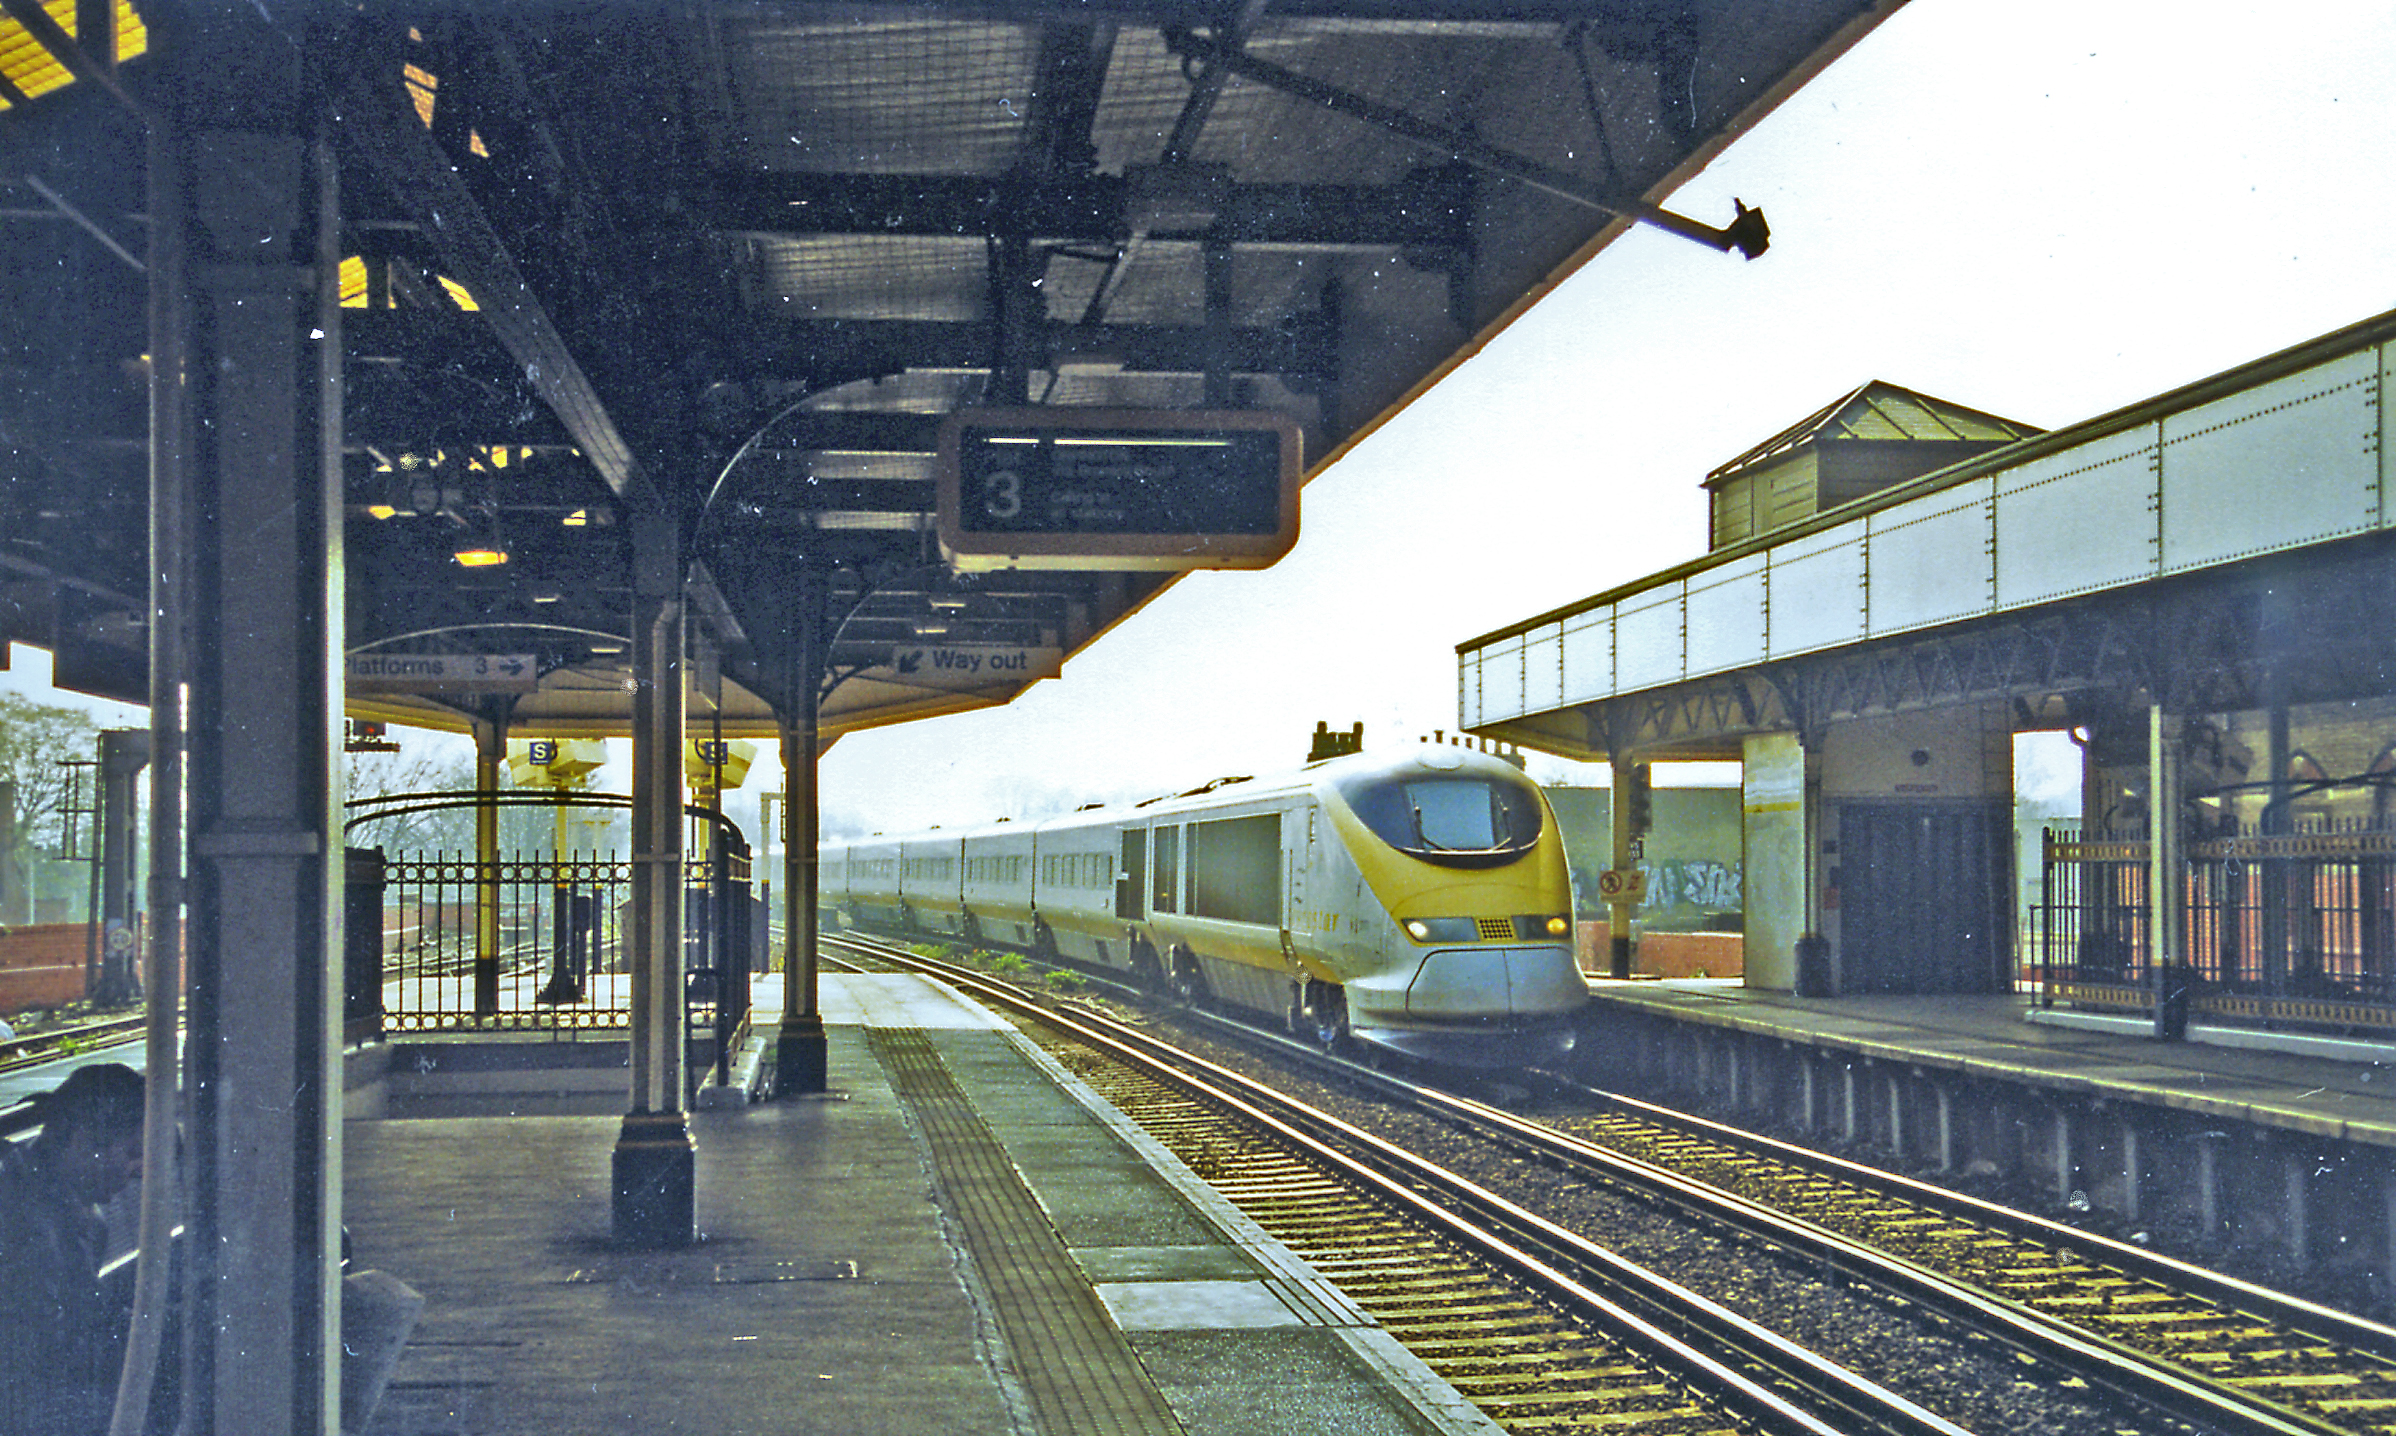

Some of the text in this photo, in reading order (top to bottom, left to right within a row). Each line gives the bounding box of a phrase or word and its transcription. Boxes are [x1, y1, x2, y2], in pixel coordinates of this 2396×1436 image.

[986, 471, 1021, 518] 3
[475, 657, 487, 675] 3
[932, 650, 1027, 673] Way out
[534, 743, 547, 759] S
